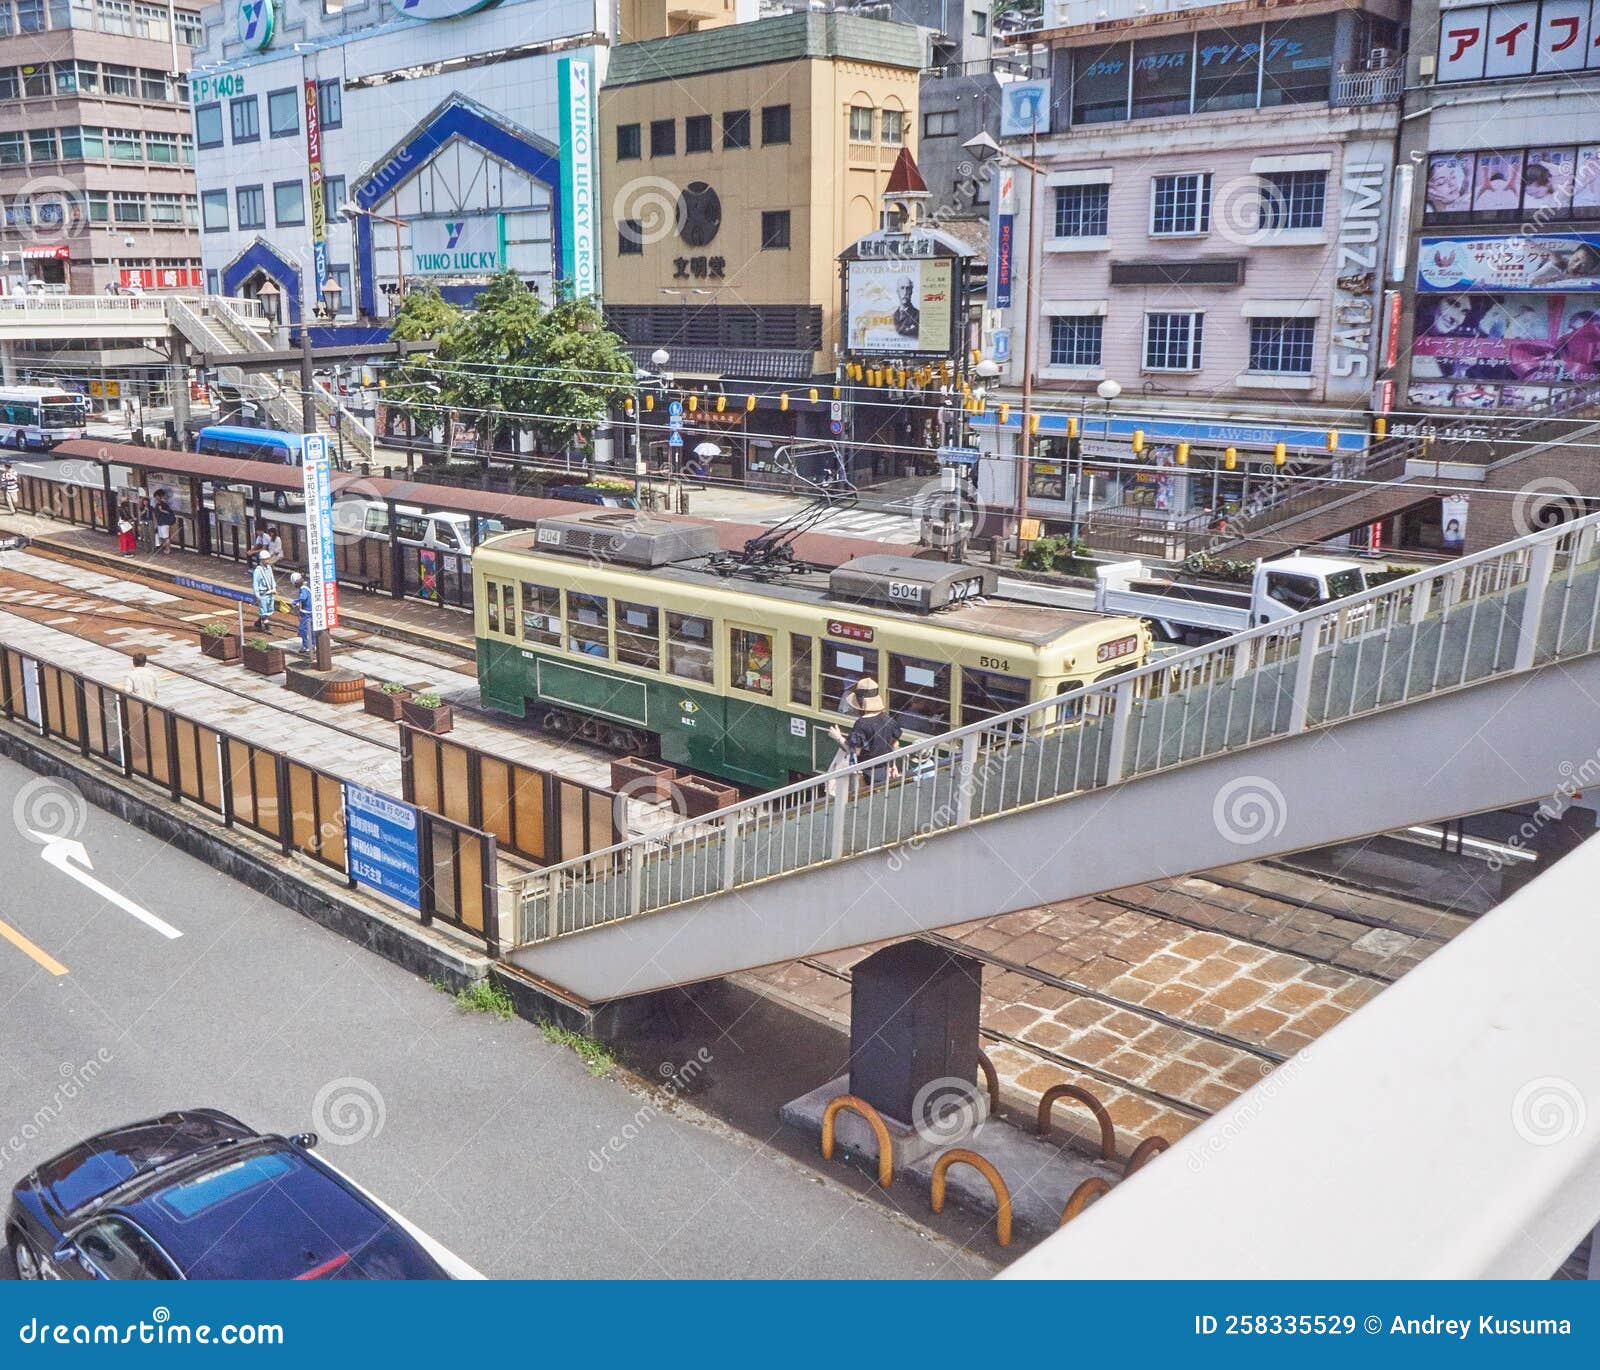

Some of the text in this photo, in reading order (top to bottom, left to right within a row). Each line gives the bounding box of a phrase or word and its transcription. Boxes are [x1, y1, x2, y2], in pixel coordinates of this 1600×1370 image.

[1448, 16, 1600, 62] アイフ
[308, 106, 319, 158] パチンコ
[574, 95, 588, 155] YUKO
[576, 163, 590, 229] LUCKY
[416, 251, 497, 271] YUKO LUCKY
[1000, 225, 1010, 285] PROMISE
[673, 257, 726, 281] 文明堂
[1207, 427, 1274, 442] LAWSON
[540, 529, 560, 543] 504
[892, 582, 919, 599] 504
[980, 656, 1010, 671] 504
